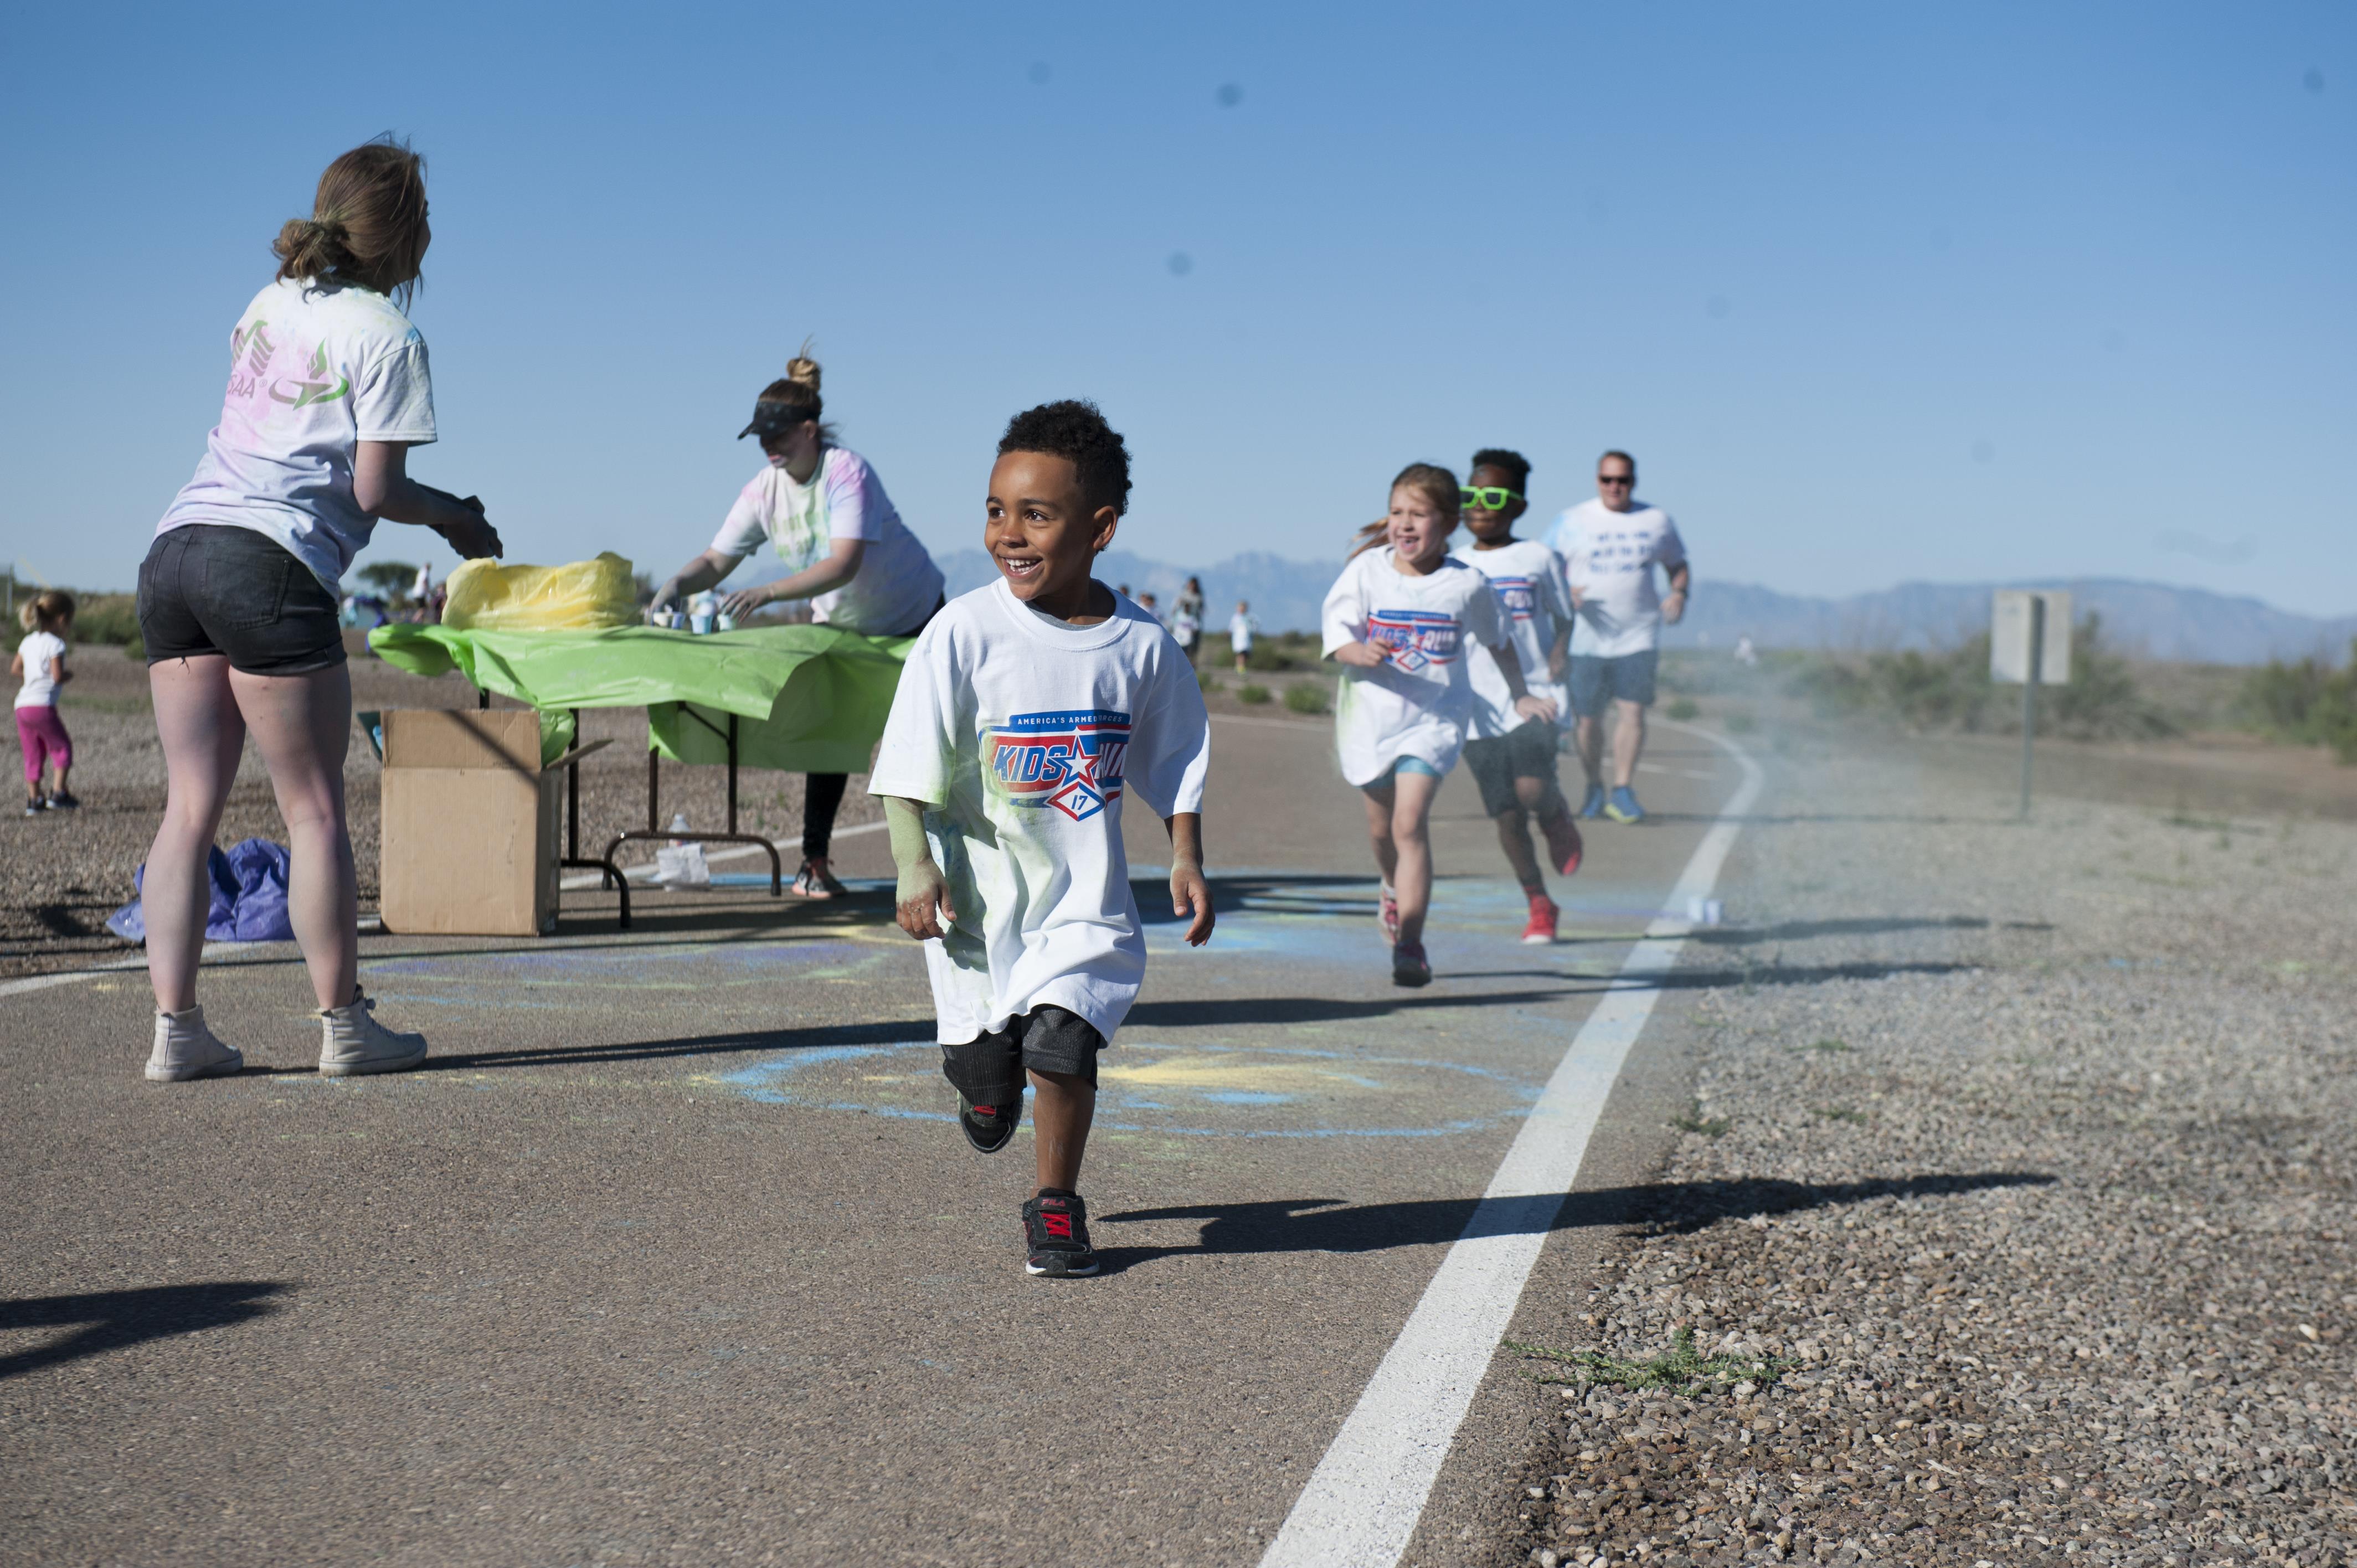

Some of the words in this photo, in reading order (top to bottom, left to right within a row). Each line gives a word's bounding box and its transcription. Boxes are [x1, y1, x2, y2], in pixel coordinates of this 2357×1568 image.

[227, 374, 255, 399] SAA
[1017, 716, 1066, 725] AMERICA'S
[1068, 715, 1097, 724] ARMED
[1098, 714, 1123, 723] RCES
[992, 744, 1069, 783] KIDS
[1071, 795, 1088, 811] 17
[1041, 1198, 1066, 1207] FILA
